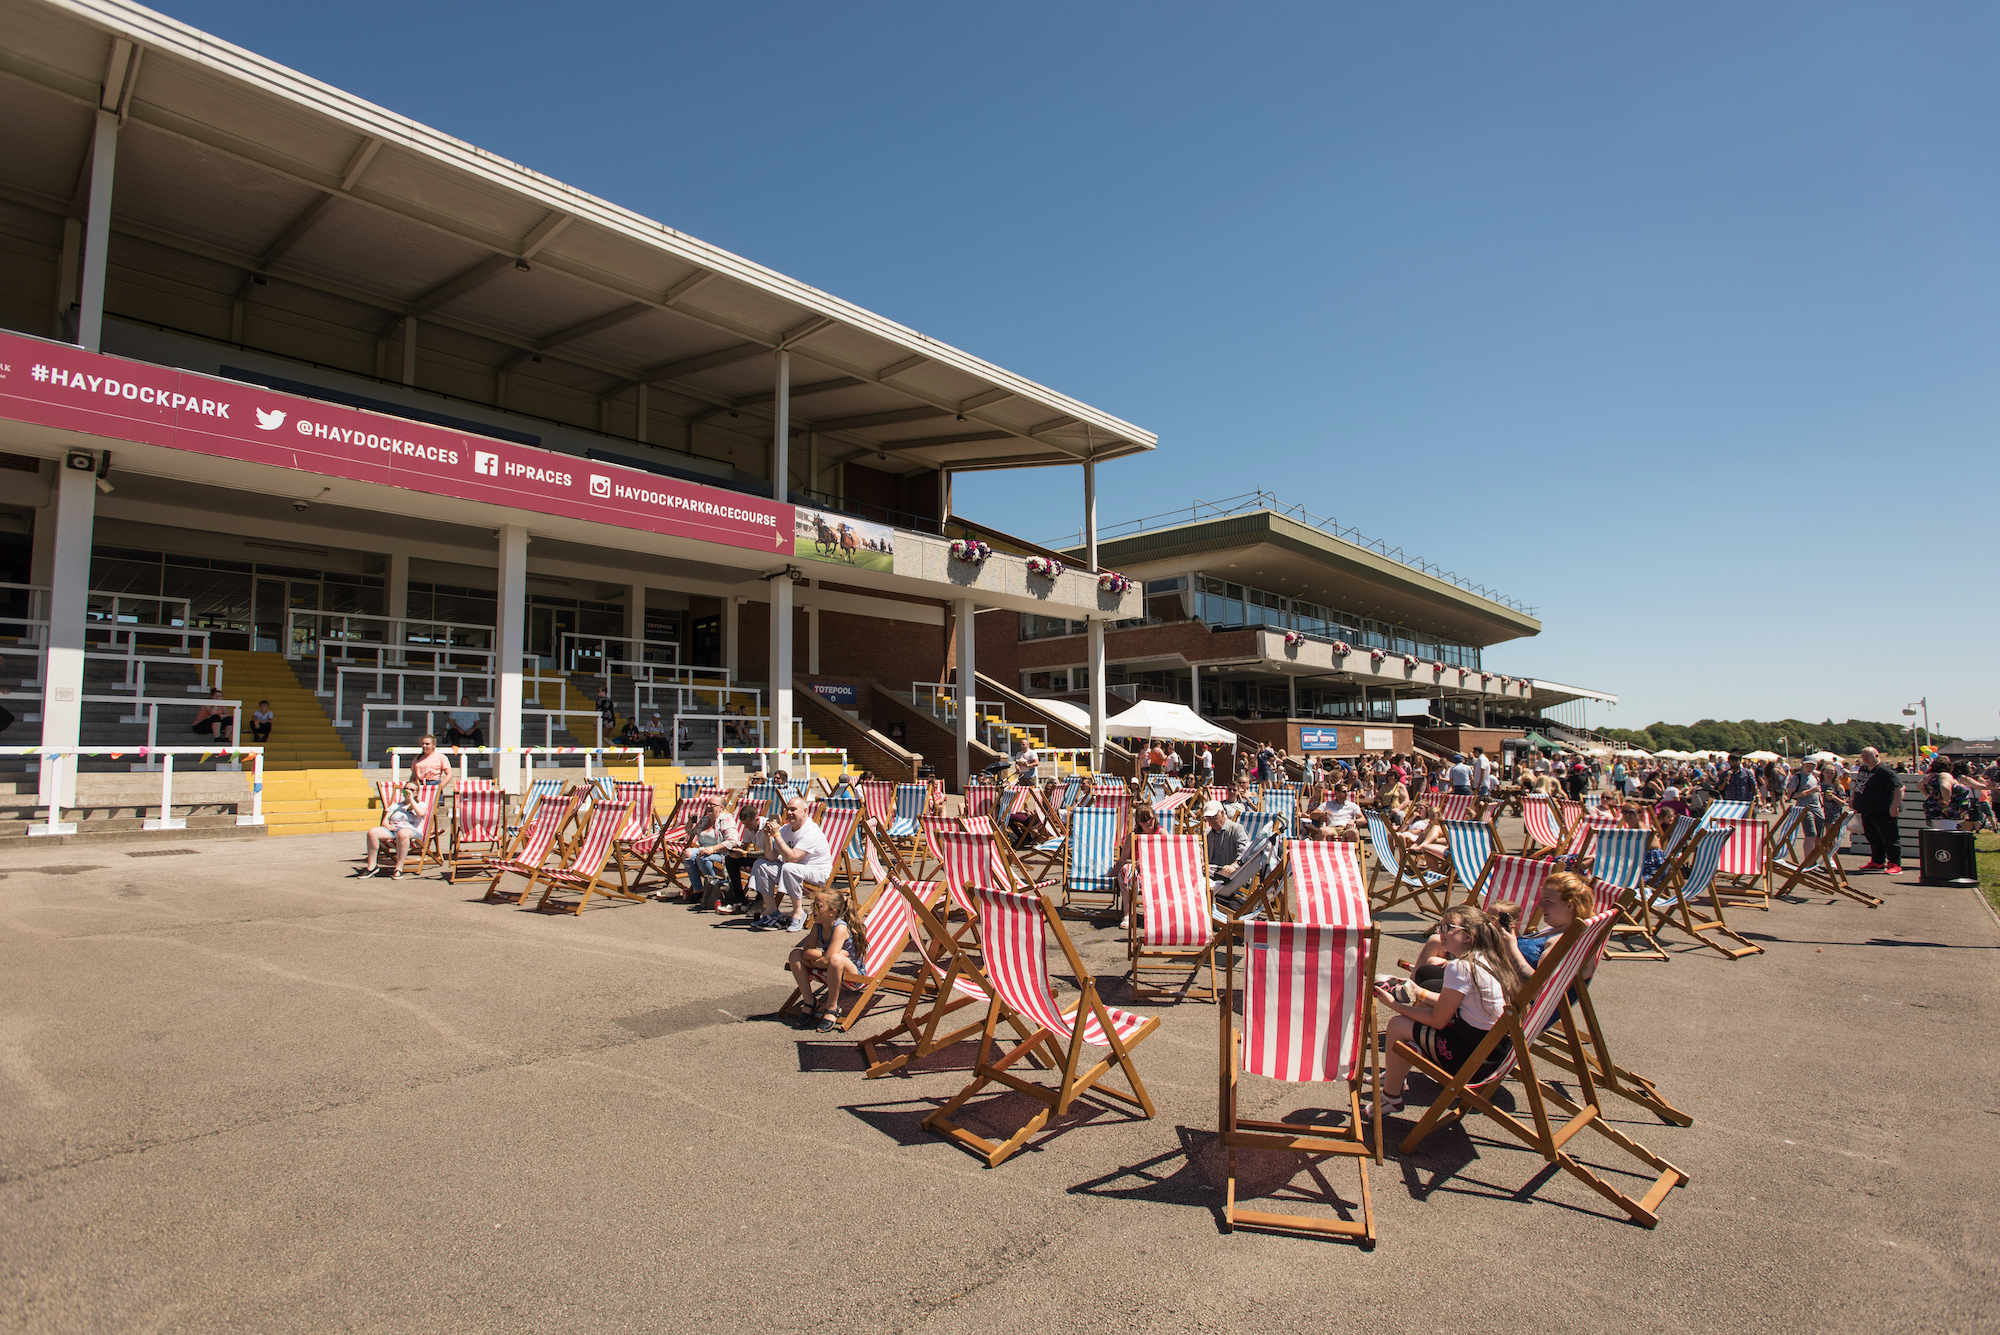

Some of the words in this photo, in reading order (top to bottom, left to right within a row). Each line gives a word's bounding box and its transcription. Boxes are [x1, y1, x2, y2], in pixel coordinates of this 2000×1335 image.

[31, 363, 231, 420] #HAYDOCKPARK
[296, 419, 459, 465] @HAYDOCKRACES
[504, 461, 573, 488] HPRACES
[615, 484, 777, 528] HAYDOCKPARKRACECOURSE
[646, 622, 673, 630] TOTEPOOL
[814, 685, 852, 695] TOTEPOOL
